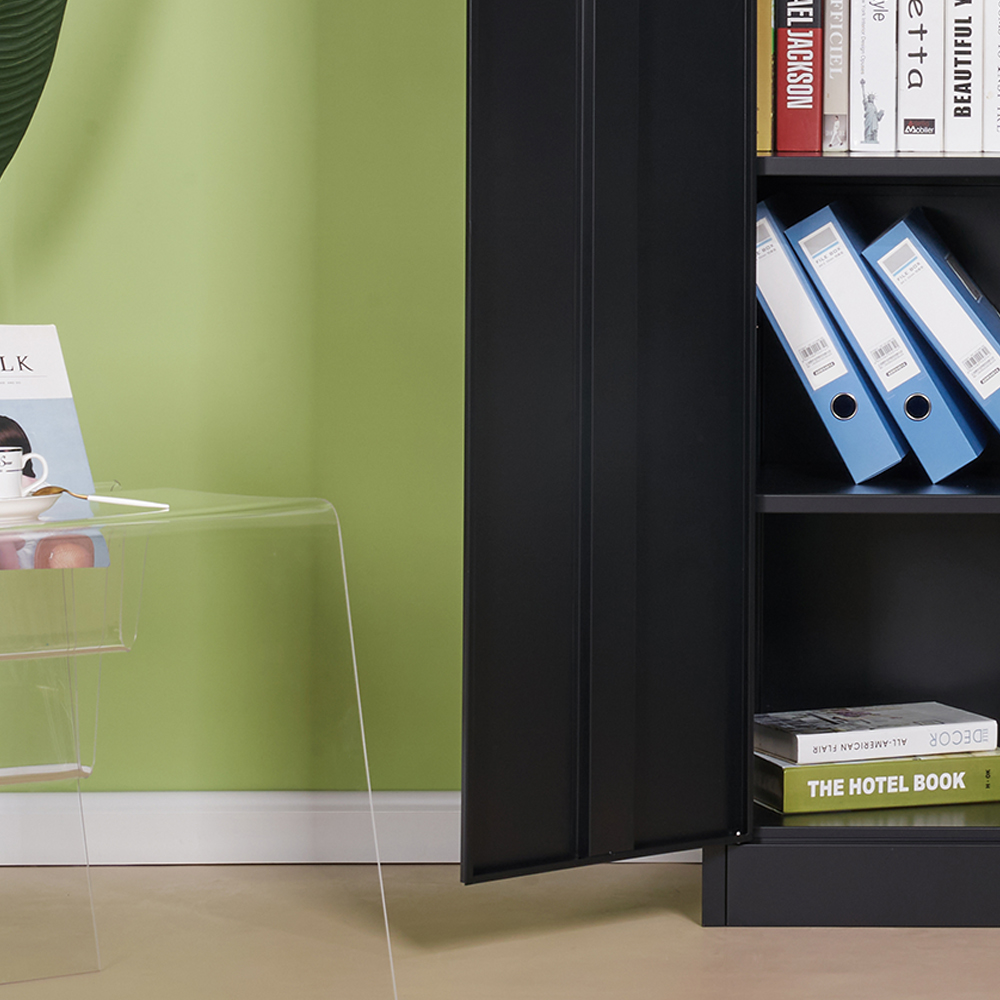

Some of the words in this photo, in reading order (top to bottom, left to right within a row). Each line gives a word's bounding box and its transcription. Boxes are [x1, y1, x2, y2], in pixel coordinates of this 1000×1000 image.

[786, 29, 814, 109] JACKSON
[953, 16, 972, 117] BEAUTIFUL
[841, 738, 907, 751] ALL-AMERICAN
[929, 728, 982, 747] DECOR
[812, 745, 837, 754] FLAIR
[807, 778, 844, 798] THE
[849, 775, 909, 796] HOTEL
[913, 771, 966, 792] BOOK
